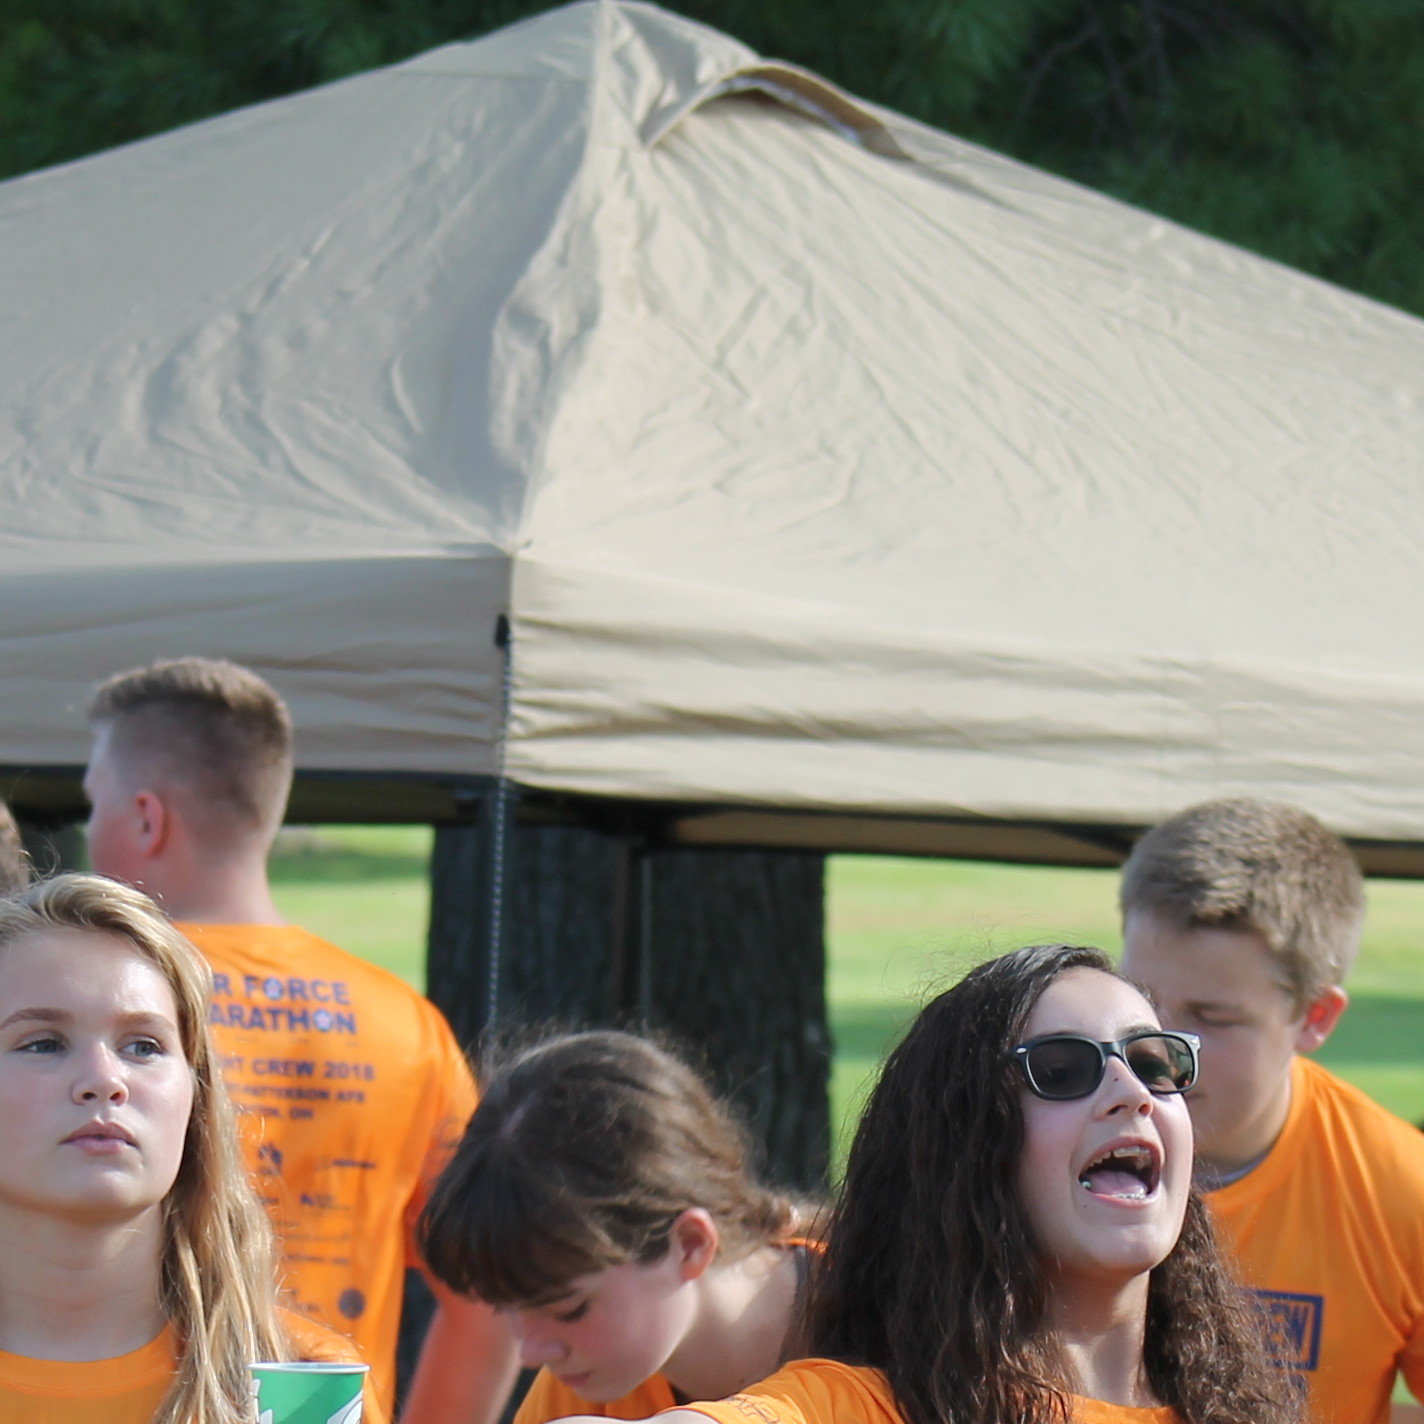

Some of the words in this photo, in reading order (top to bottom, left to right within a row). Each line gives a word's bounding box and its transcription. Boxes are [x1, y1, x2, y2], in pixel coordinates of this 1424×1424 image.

[244, 974, 352, 1006] FORCE
[209, 1003, 358, 1036] ARATHON
[252, 1058, 317, 1078] CREW
[324, 1061, 376, 1082] 2018
